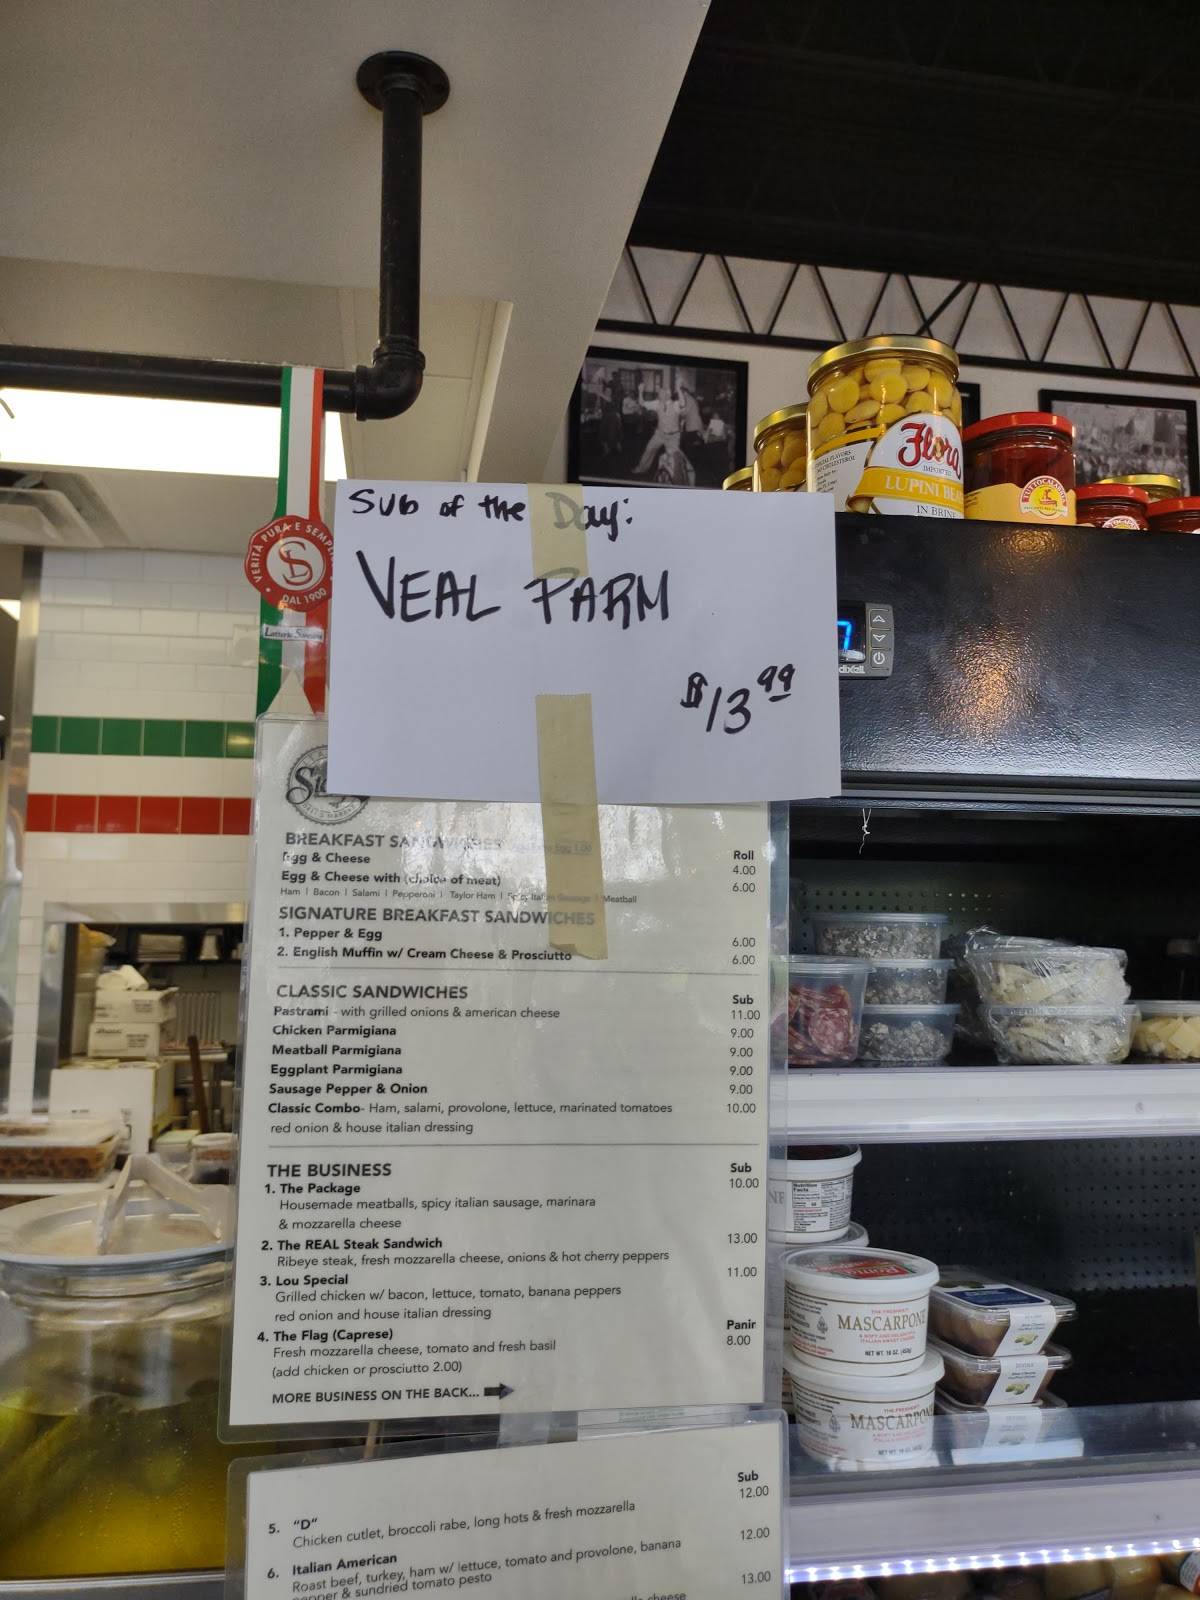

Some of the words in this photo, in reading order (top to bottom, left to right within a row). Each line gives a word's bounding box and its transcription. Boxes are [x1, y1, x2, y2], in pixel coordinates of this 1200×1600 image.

[898, 423, 961, 480] Flora
[886, 476, 940, 495] LUPINI
[348, 488, 419, 516] Sub
[439, 499, 464, 521] of
[478, 496, 526, 522] the
[545, 491, 634, 542] Day:
[917, 505, 928, 513] IN
[261, 522, 292, 543] PURA
[295, 522, 300, 531] E
[282, 594, 302, 605] DAL
[304, 587, 326, 604] 1900
[356, 550, 501, 623] VEAL
[523, 566, 672, 630] PARM
[285, 832, 384, 847] BREAKFAST
[312, 852, 321, 862] &
[326, 852, 370, 864] Cheese
[734, 850, 754, 860] Roll
[733, 866, 756, 875] 4.00
[282, 871, 306, 884] Egg
[311, 871, 320, 882] &
[325, 872, 370, 883] Cheese
[374, 872, 400, 883] with
[451, 874, 464, 884] of
[467, 875, 500, 888] meat)
[732, 883, 756, 892] 6.00
[281, 888, 300, 896] Ham
[352, 889, 380, 897] Salami
[392, 890, 435, 900] Pepperoni
[450, 891, 474, 900] Taylor
[476, 892, 495, 900] Ham
[279, 907, 377, 921] SIGNATURE
[383, 909, 478, 922] BREAKFAST
[484, 909, 595, 926] SANDWICHES
[279, 928, 289, 937] 1.
[294, 928, 339, 941] Pepper
[344, 929, 353, 938] &
[358, 929, 382, 940] Egg
[732, 938, 756, 947] 6.00
[277, 947, 288, 956] 2.
[294, 947, 337, 960] English
[342, 947, 382, 958] Muffin
[387, 948, 402, 959] w/
[407, 949, 446, 959] Cream
[450, 950, 494, 959] Cheese
[499, 950, 507, 959] &
[512, 951, 572, 960] Prosciutto
[732, 955, 756, 965] 6.00
[277, 985, 347, 998] CLASSIC
[353, 986, 468, 999] SANDWICHES
[732, 995, 754, 1005] Sub
[273, 1006, 329, 1016] Pastrami
[341, 1006, 365, 1017] with
[370, 1007, 406, 1019] grilled
[411, 1007, 449, 1017] onions
[453, 1007, 461, 1017] &
[465, 1008, 517, 1018] american
[520, 1008, 560, 1018] cheese
[731, 1010, 760, 1020] 11.00
[272, 1025, 322, 1035] Chicken
[327, 1025, 396, 1038] Parmigiana
[731, 1029, 754, 1038] 9.00
[272, 1045, 327, 1055] Meatball
[332, 1045, 401, 1057] Parmigiana
[730, 1048, 753, 1057] 9.00
[271, 1064, 328, 1077] Eggplant
[333, 1065, 402, 1077] Parmigiana
[729, 1066, 753, 1076] 9.00
[269, 1084, 321, 1096] Sausage
[326, 1084, 372, 1096] Pepper
[376, 1084, 386, 1094] &
[390, 1084, 427, 1094] Onion
[729, 1085, 753, 1095] 9.00
[268, 1103, 311, 1113] Classic
[370, 1103, 400, 1115] Ham,
[404, 1103, 445, 1115] salami,
[448, 1103, 510, 1116] provolone,
[514, 1102, 556, 1114] lettuce,
[560, 1103, 617, 1113] marinated
[621, 1103, 672, 1113] tomatoes
[727, 1103, 756, 1113] 10.00
[267, 1164, 301, 1177] THE
[308, 1164, 392, 1177] BUSINESS
[731, 1163, 752, 1173] Sub
[265, 1184, 275, 1194] 1.
[280, 1183, 303, 1194] The
[308, 1183, 361, 1196] Package
[729, 1179, 759, 1189] 10.00
[261, 1241, 272, 1251] 2.
[278, 1240, 300, 1251] The
[305, 1240, 339, 1250] REAL
[344, 1239, 379, 1250] Steak
[384, 1238, 442, 1248] Sandwich
[728, 1233, 757, 1244] 13.00
[728, 1267, 757, 1277] 11.00
[260, 1276, 271, 1286] 3.
[276, 1276, 299, 1286] Lou
[303, 1275, 348, 1287] Special
[727, 1320, 756, 1330] Panir
[257, 1332, 269, 1342] 4.
[274, 1331, 297, 1342] The
[302, 1330, 328, 1343] Flag
[333, 1328, 393, 1342] (Caprese)
[726, 1336, 750, 1345] 8.00
[272, 1393, 311, 1404] MORE
[316, 1391, 377, 1402] BUSINESS
[381, 1390, 401, 1400] ON
[406, 1389, 430, 1399] THE
[434, 1387, 480, 1399] BACK...
[737, 1471, 759, 1483] Sub
[739, 1486, 769, 1499] 12.00
[269, 1524, 280, 1534] 5.
[293, 1532, 342, 1548] Chicken
[346, 1528, 384, 1542] cutlet,
[388, 1521, 436, 1537] broccoli
[440, 1519, 469, 1532] rabe,
[474, 1516, 500, 1530] long
[503, 1511, 528, 1524] hots
[532, 1510, 542, 1521] &
[545, 1507, 572, 1520] fresh
[576, 1500, 635, 1517] mozzarella
[740, 1527, 770, 1540] 12.00
[267, 1568, 279, 1579] 6.
[293, 1562, 332, 1575] Italian
[337, 1554, 397, 1570] American
[741, 1571, 771, 1584] 13.00
